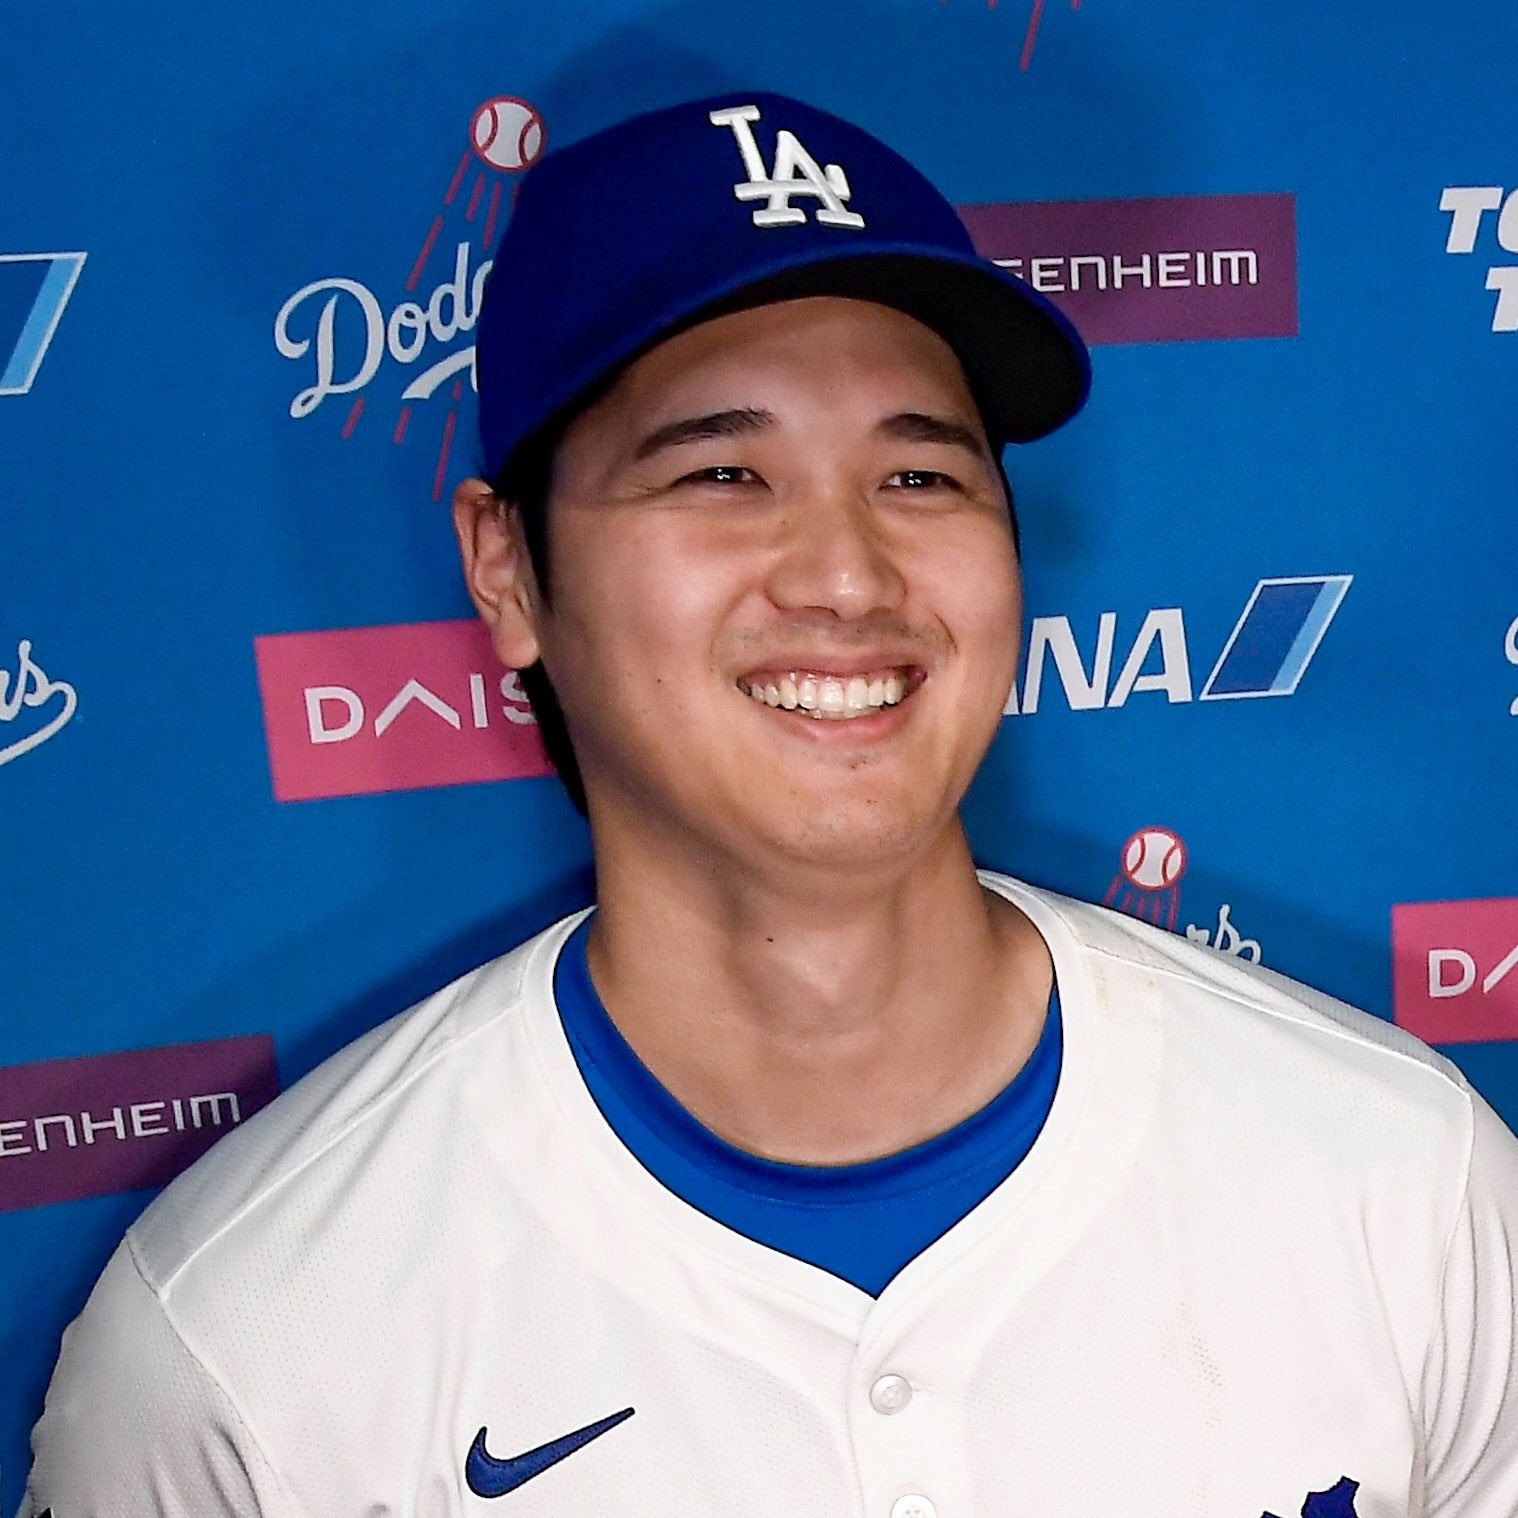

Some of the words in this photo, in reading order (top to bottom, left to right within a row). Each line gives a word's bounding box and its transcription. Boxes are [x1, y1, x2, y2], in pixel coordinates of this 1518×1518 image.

[709, 105, 866, 229] LA
[992, 250, 1258, 292] ENHEIM
[304, 670, 538, 744] DAIS
[0, 1092, 241, 1157] ENHEIM
